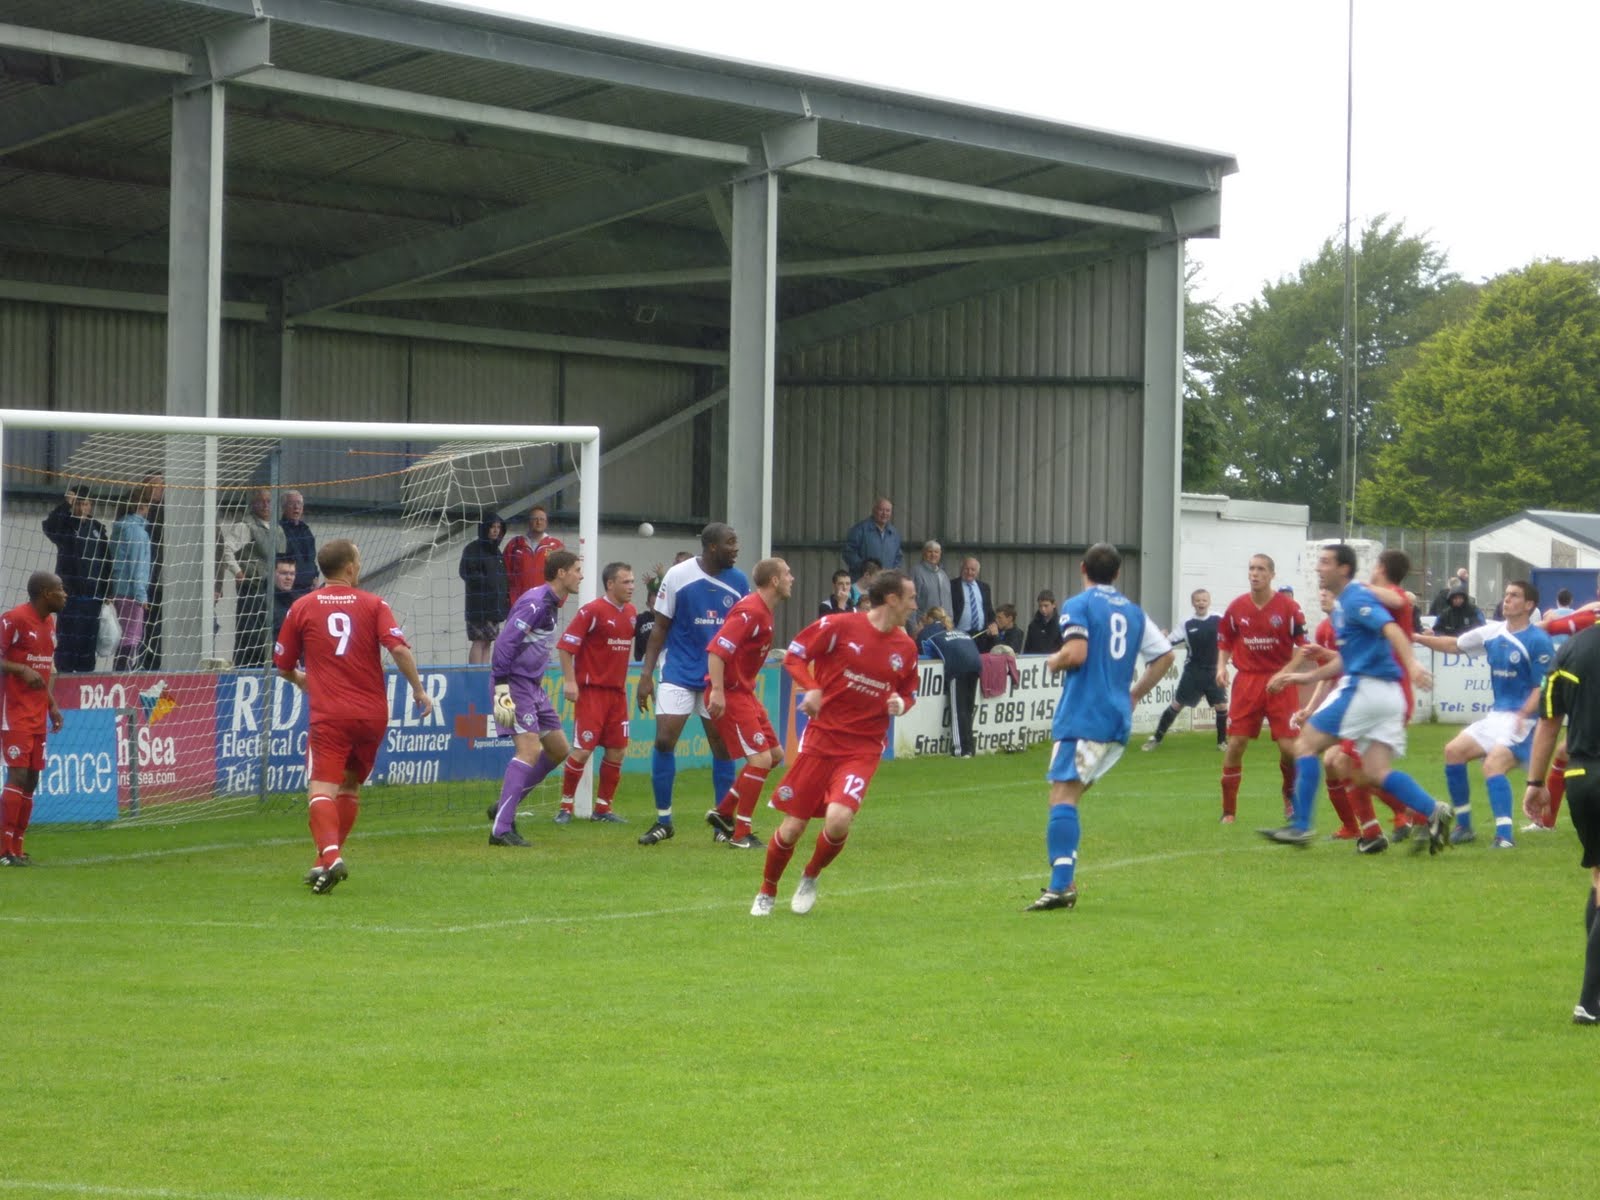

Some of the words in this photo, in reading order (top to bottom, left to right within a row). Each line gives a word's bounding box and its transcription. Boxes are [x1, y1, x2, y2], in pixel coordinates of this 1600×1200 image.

[327, 612, 351, 656] 9
[1110, 612, 1128, 660] 8
[231, 676, 259, 731] R
[994, 701, 1025, 724] 889
[1030, 699, 1055, 721] 145
[1440, 702, 1464, 713] Tel:
[138, 726, 177, 767] Sea
[387, 729, 451, 753] Stranraer
[225, 763, 256, 792] Tel:
[387, 759, 440, 785] 889101
[842, 774, 865, 801] 12
